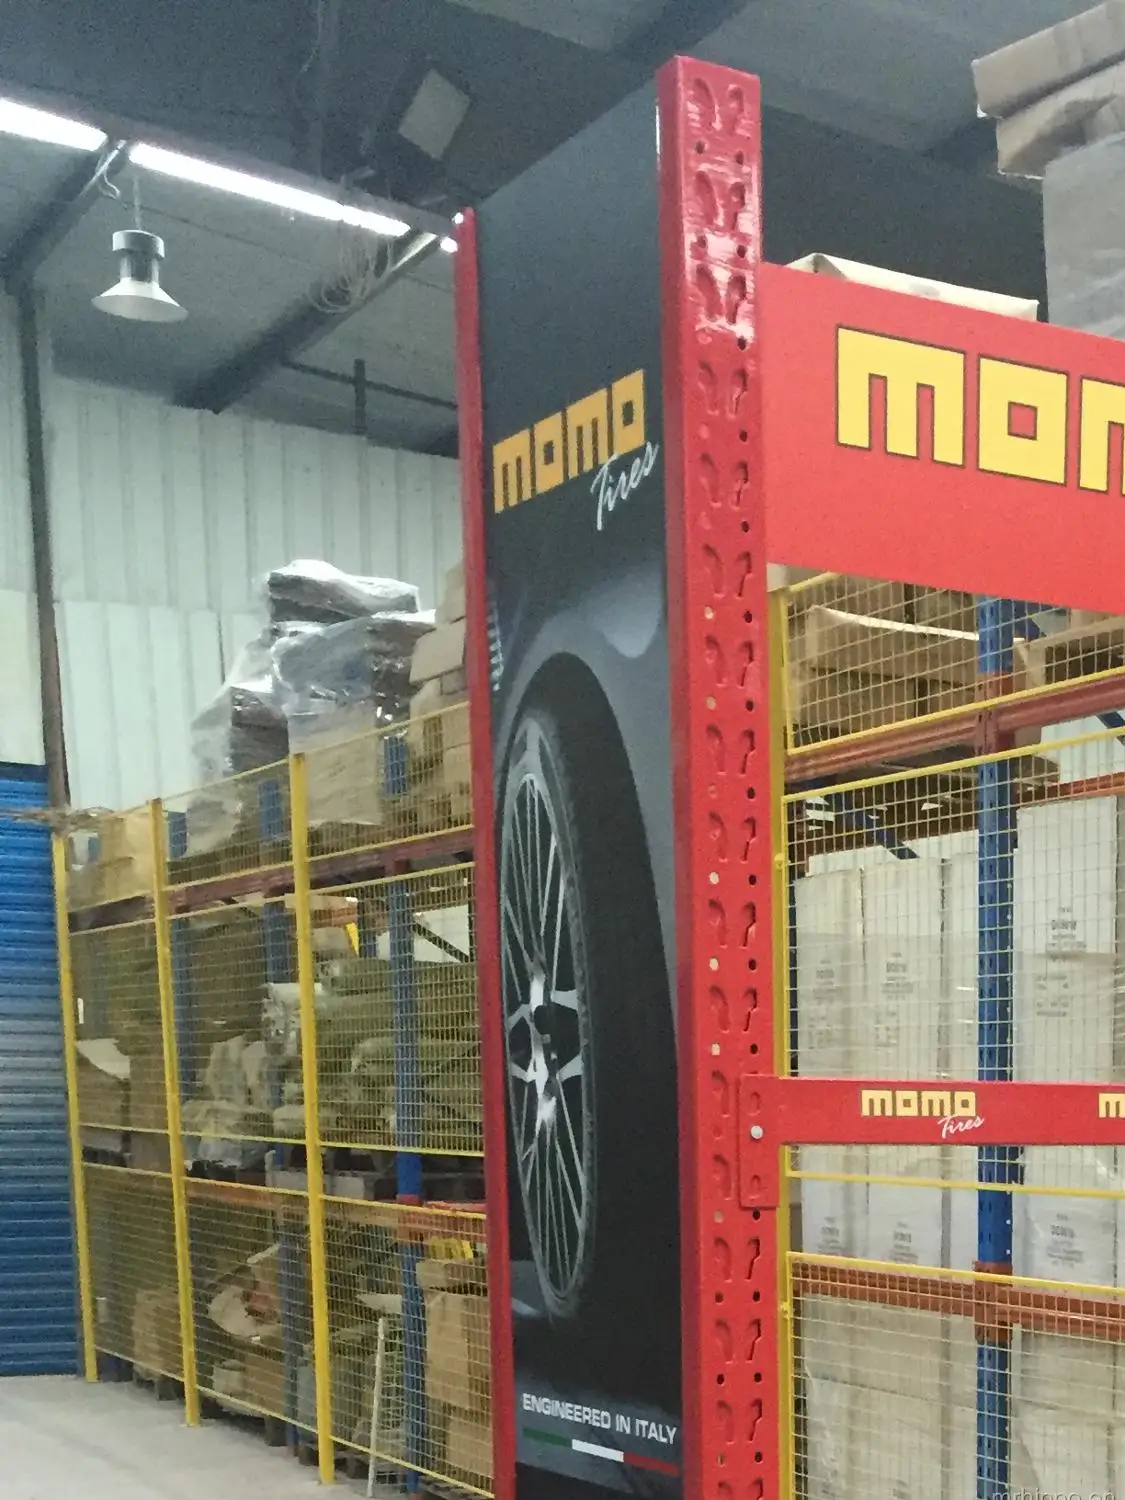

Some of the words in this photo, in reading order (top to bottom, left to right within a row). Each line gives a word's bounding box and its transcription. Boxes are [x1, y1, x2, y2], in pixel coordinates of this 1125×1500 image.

[590, 441, 659, 530] Tires
[937, 1113, 985, 1139] Tires
[522, 1392, 612, 1430] ENGINEERED
[615, 1414, 631, 1436] IN
[635, 1418, 677, 1445] ITALY
